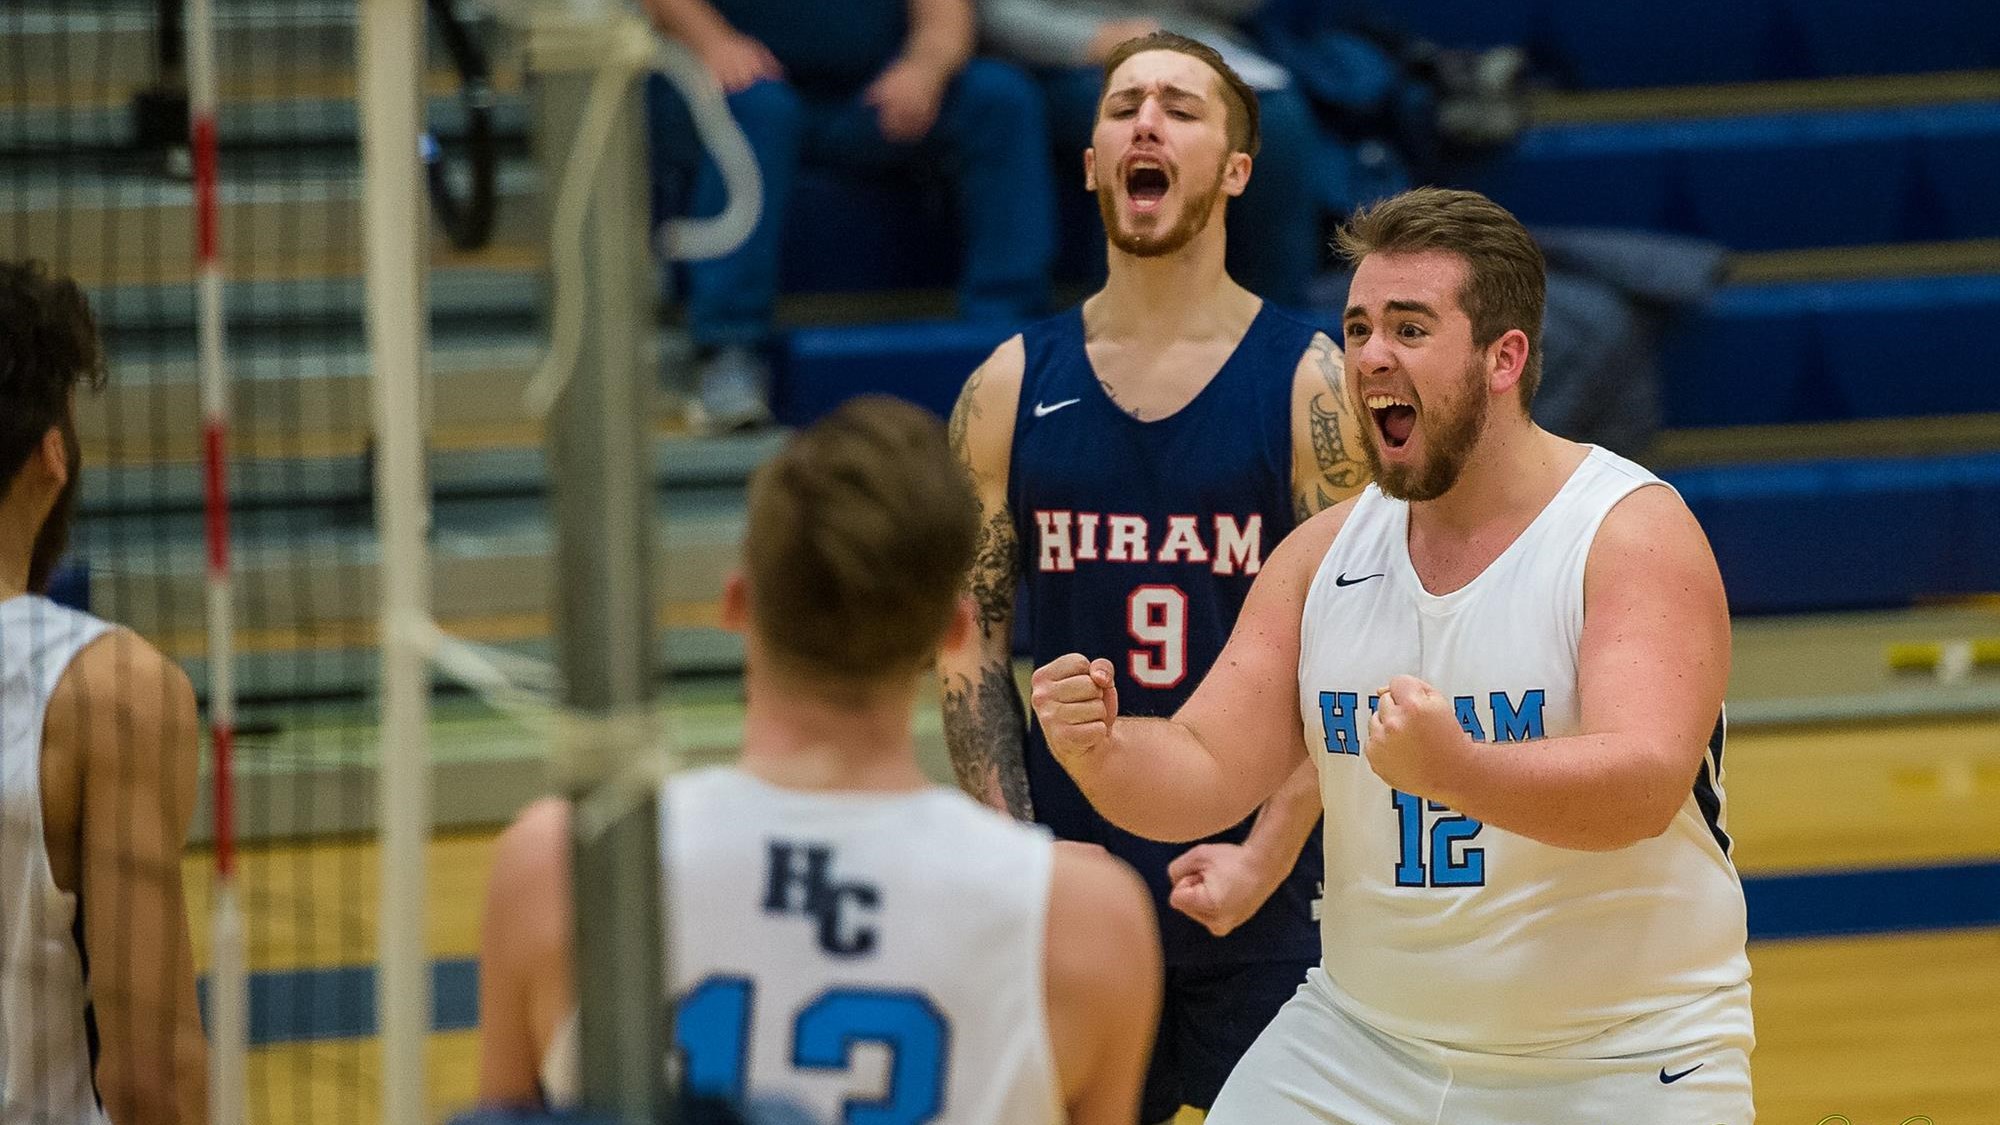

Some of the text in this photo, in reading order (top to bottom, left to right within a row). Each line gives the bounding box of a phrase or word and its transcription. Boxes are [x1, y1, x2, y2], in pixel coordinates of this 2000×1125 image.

[1034, 509, 1264, 576] HIRAM
[1127, 584, 1189, 690] 9
[1319, 688, 1546, 757] HAM
[1392, 788, 1485, 888] 12
[761, 839, 882, 957] HC
